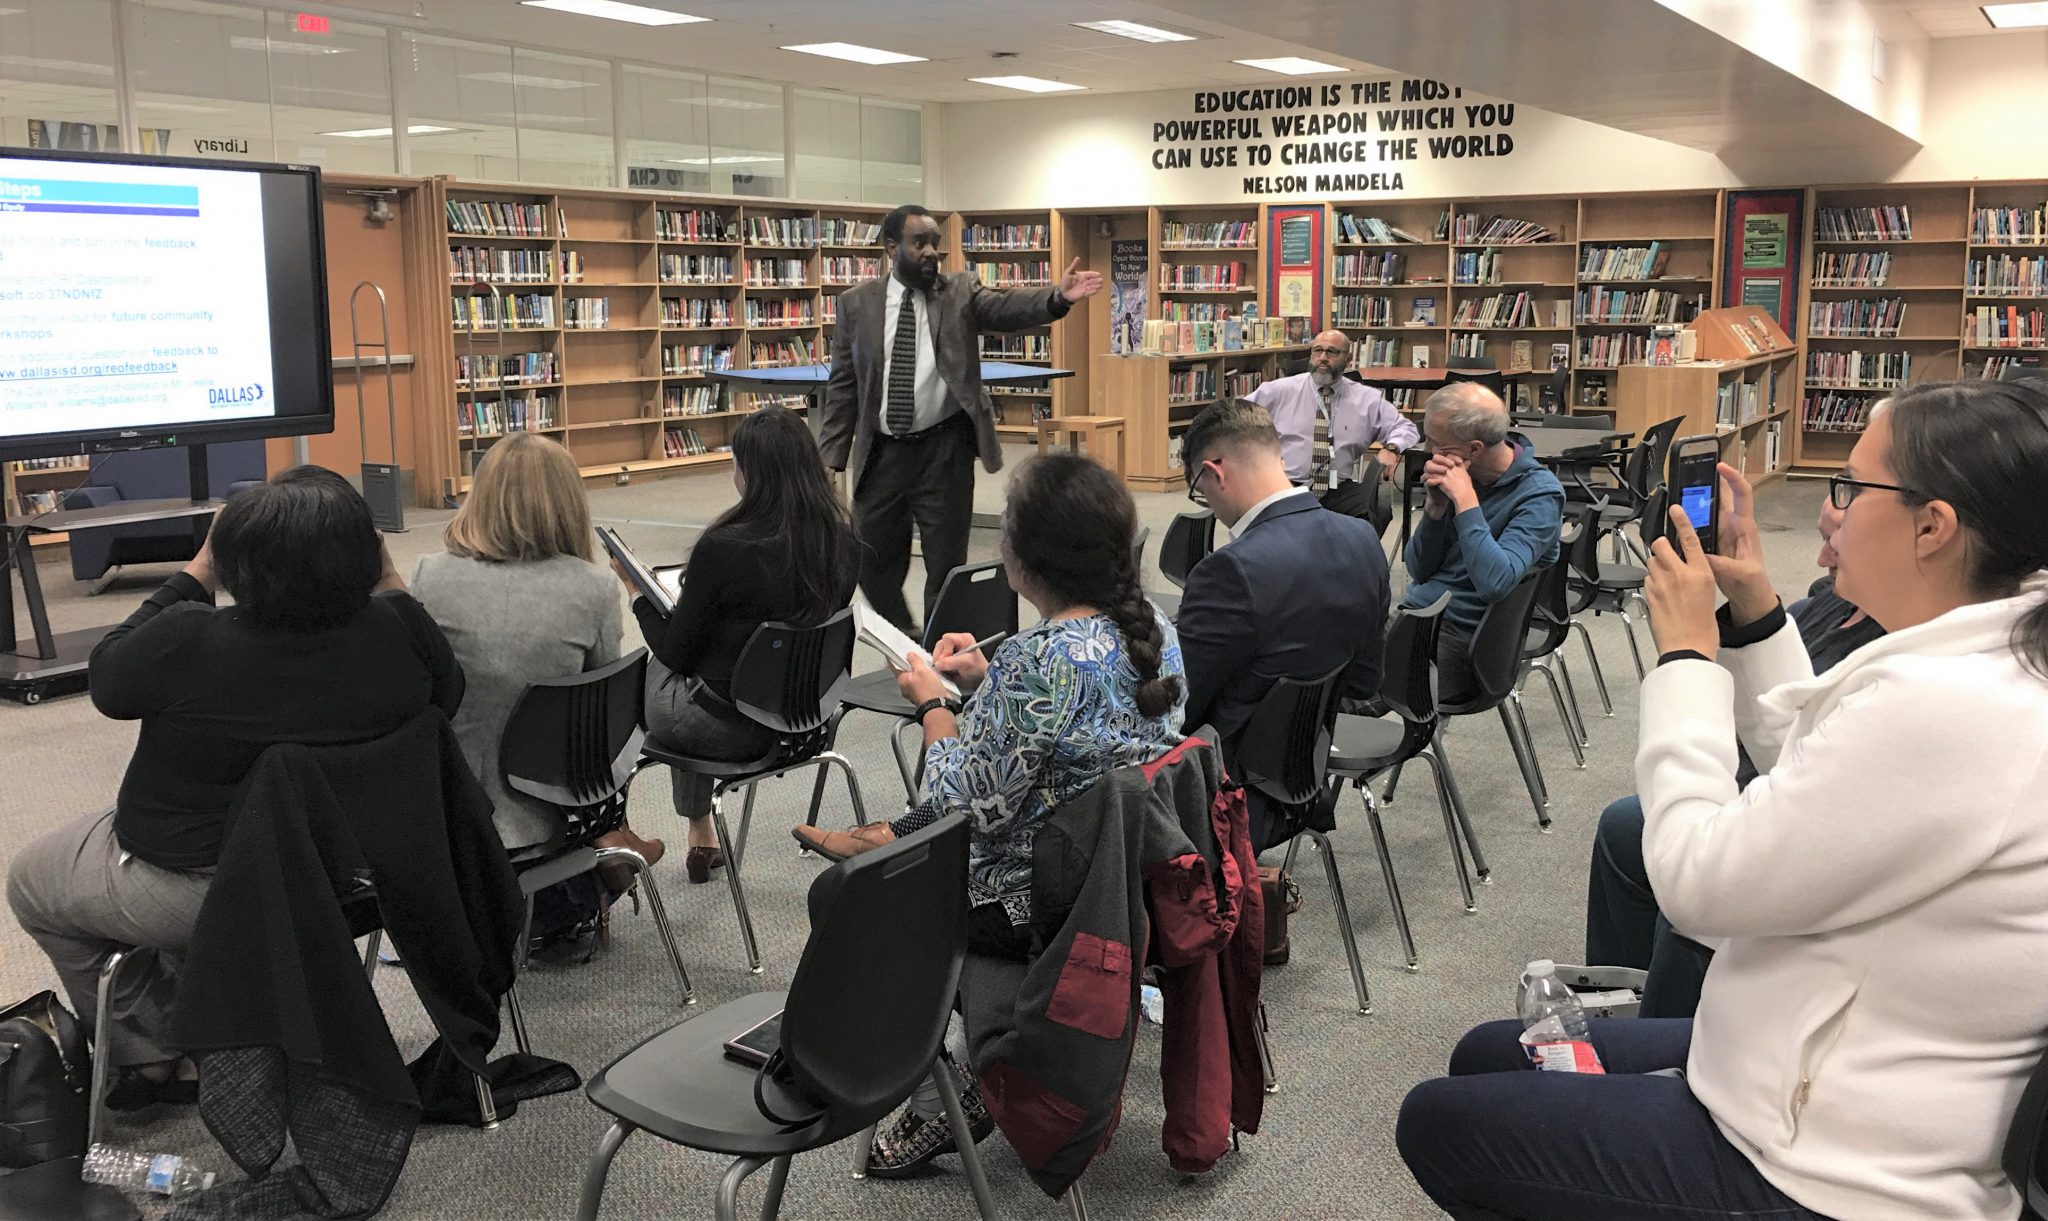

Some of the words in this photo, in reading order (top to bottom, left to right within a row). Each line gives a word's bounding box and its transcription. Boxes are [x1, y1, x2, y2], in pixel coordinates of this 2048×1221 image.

[1194, 85, 1312, 114] EDUCATION
[1321, 84, 1342, 107] IS
[1350, 80, 1392, 106] THE
[1153, 116, 1263, 142] POWERFUL
[1271, 111, 1367, 138] WEAPON
[1377, 105, 1455, 132] WHICH
[1464, 103, 1515, 129] YOU
[1151, 147, 1192, 170] CAN
[1199, 145, 1238, 169] USE
[1246, 144, 1272, 167] TO
[1280, 140, 1366, 166] CHANGE
[1378, 137, 1418, 162] THE
[1428, 133, 1514, 159] WORLD
[1243, 174, 1307, 195] NELSON
[1315, 172, 1403, 193] MANDELA
[145, 237, 197, 249] feedback
[1117, 243, 1142, 253] Books
[1112, 254, 1128, 263] Open
[1119, 263, 1127, 271] To
[1128, 263, 1141, 271] New
[112, 310, 147, 322] future
[151, 310, 214, 322] community
[152, 345, 204, 357] feedback
[207, 345, 219, 356] to
[208, 386, 255, 404] DALLAS
